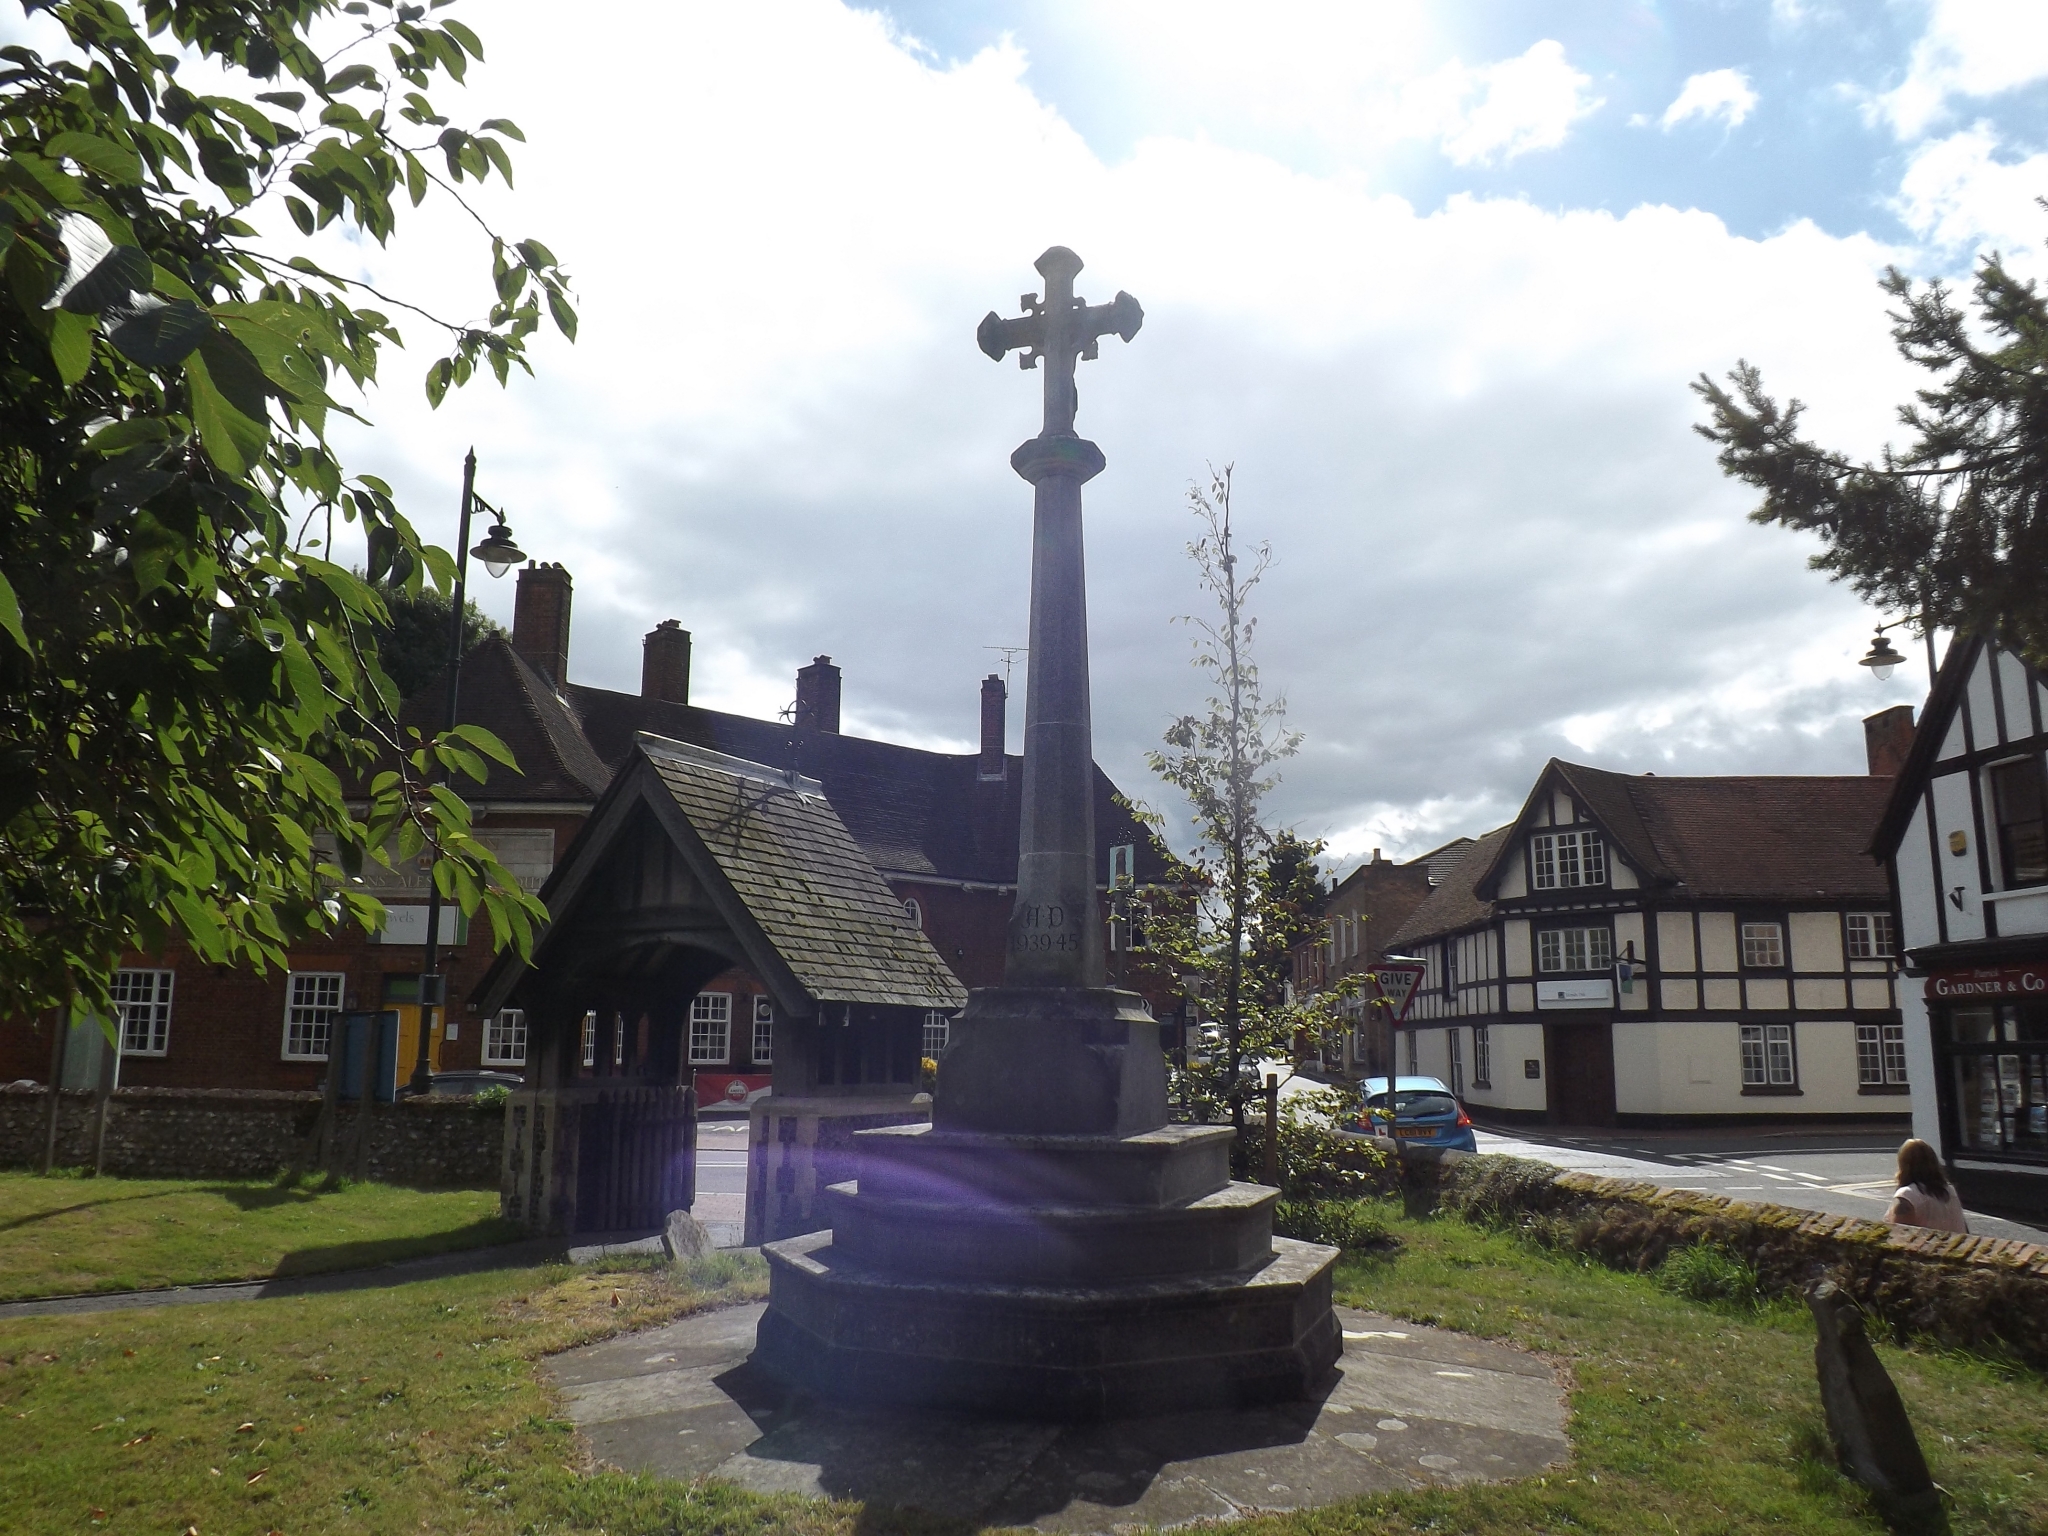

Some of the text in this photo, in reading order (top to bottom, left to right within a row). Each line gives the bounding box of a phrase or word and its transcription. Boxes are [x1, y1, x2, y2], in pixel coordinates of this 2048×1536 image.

[1380, 972, 1412, 985] GIVE
[1936, 972, 2046, 996] GARDNER & Co
[1387, 988, 1407, 998] WAY
